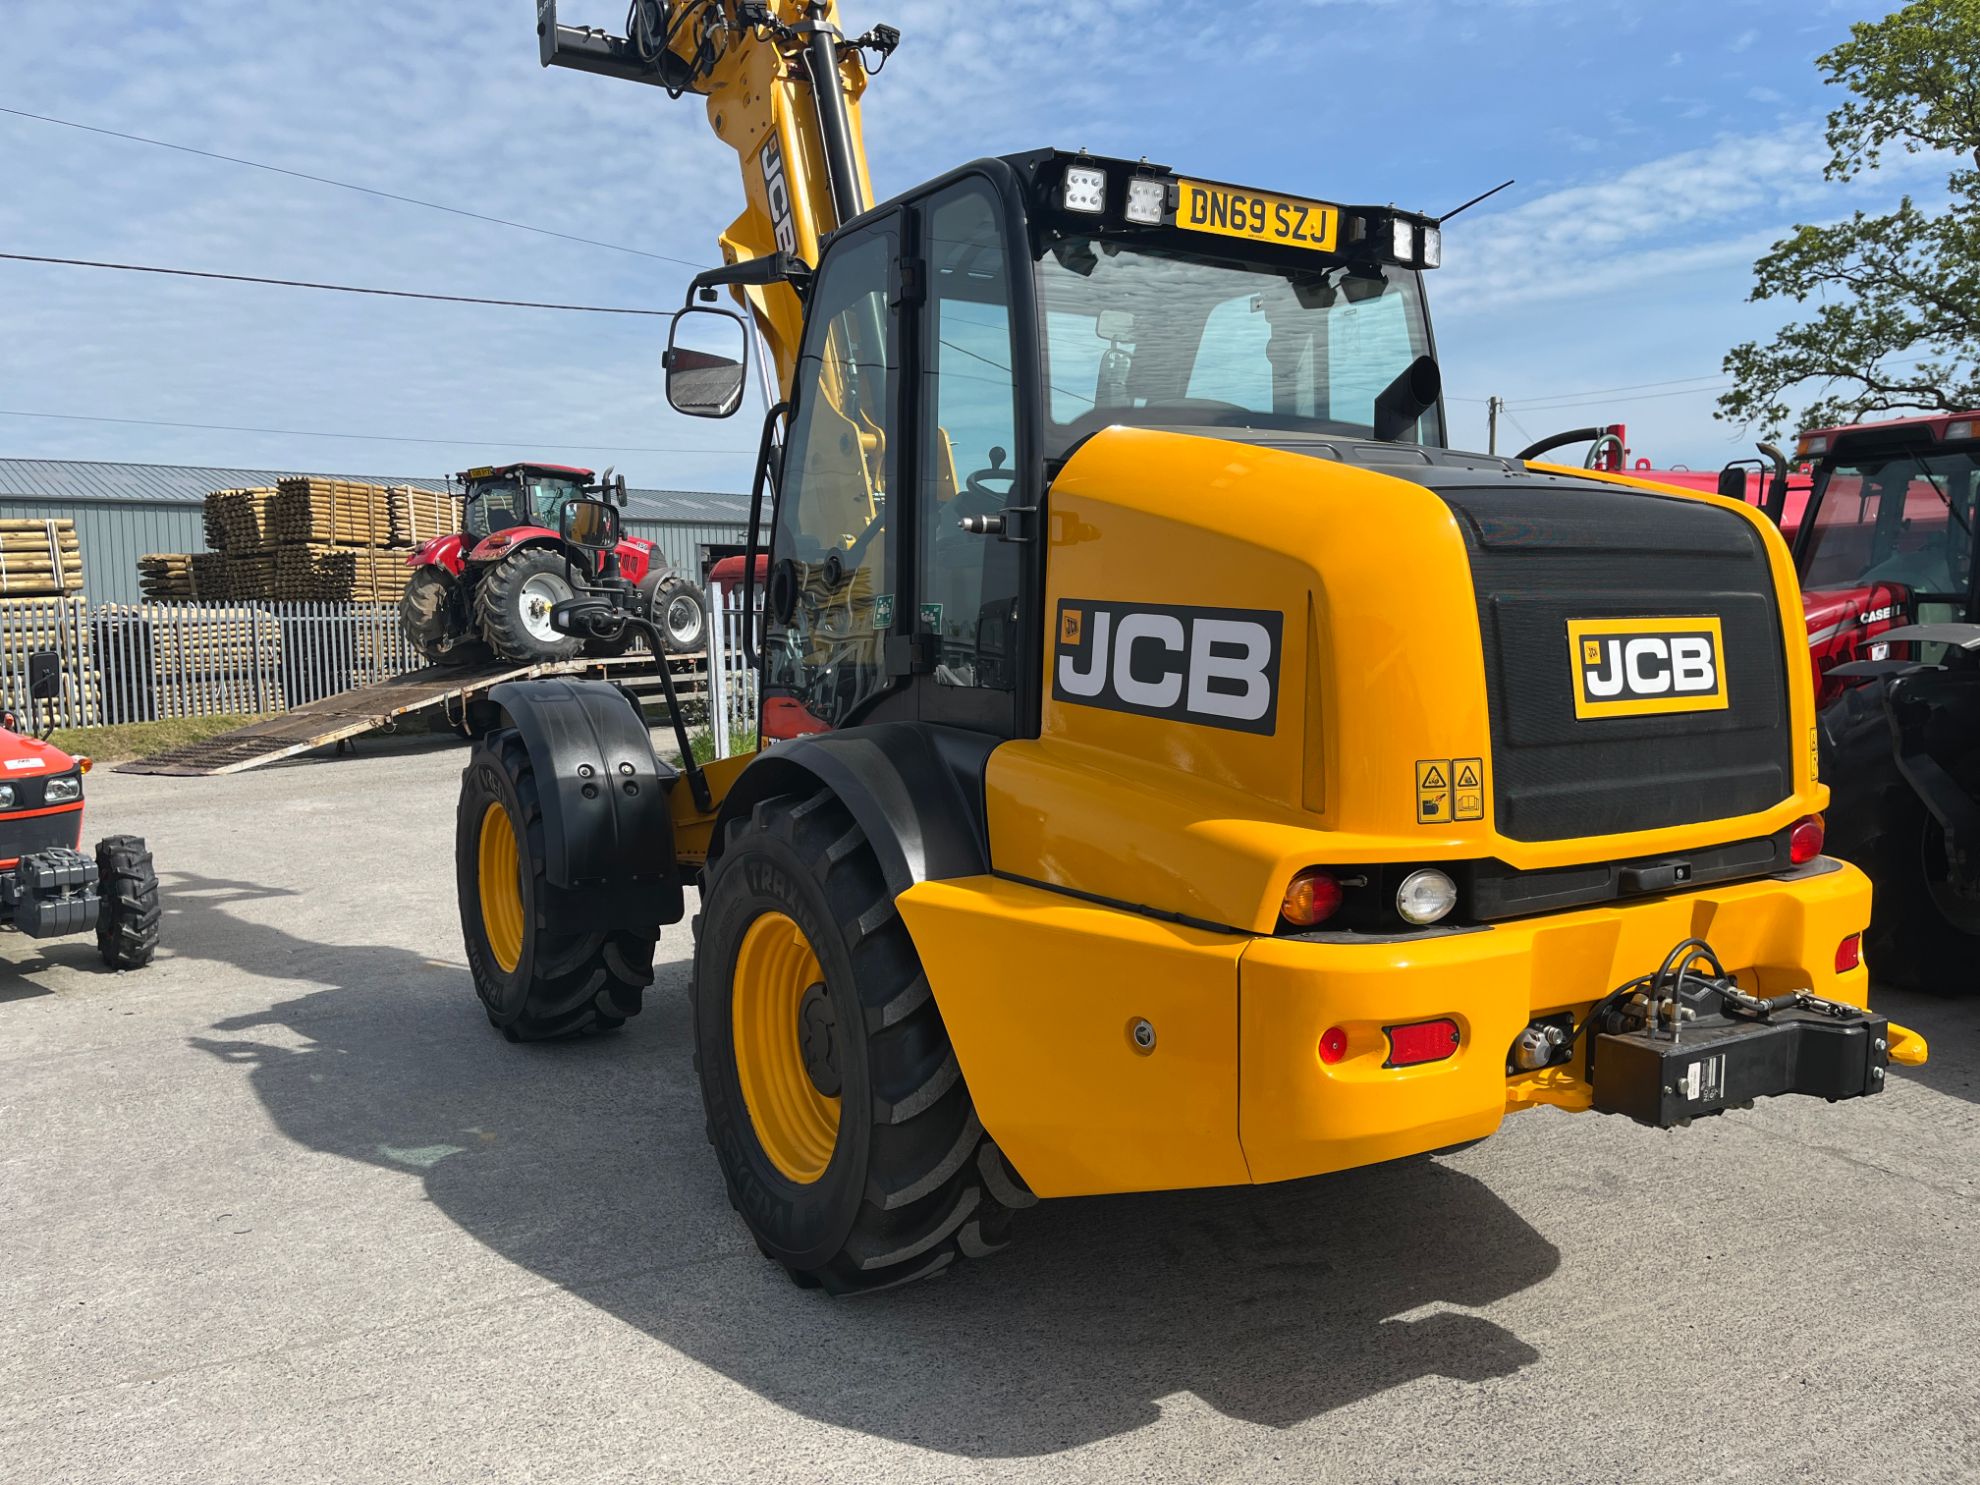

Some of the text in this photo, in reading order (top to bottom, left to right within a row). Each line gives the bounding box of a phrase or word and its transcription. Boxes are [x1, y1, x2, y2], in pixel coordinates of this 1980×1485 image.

[761, 146, 797, 257] JCB
[1190, 187, 1327, 244] DN69 SZJ
[1058, 611, 1272, 721] JCB
[1586, 637, 1715, 696] JCB
